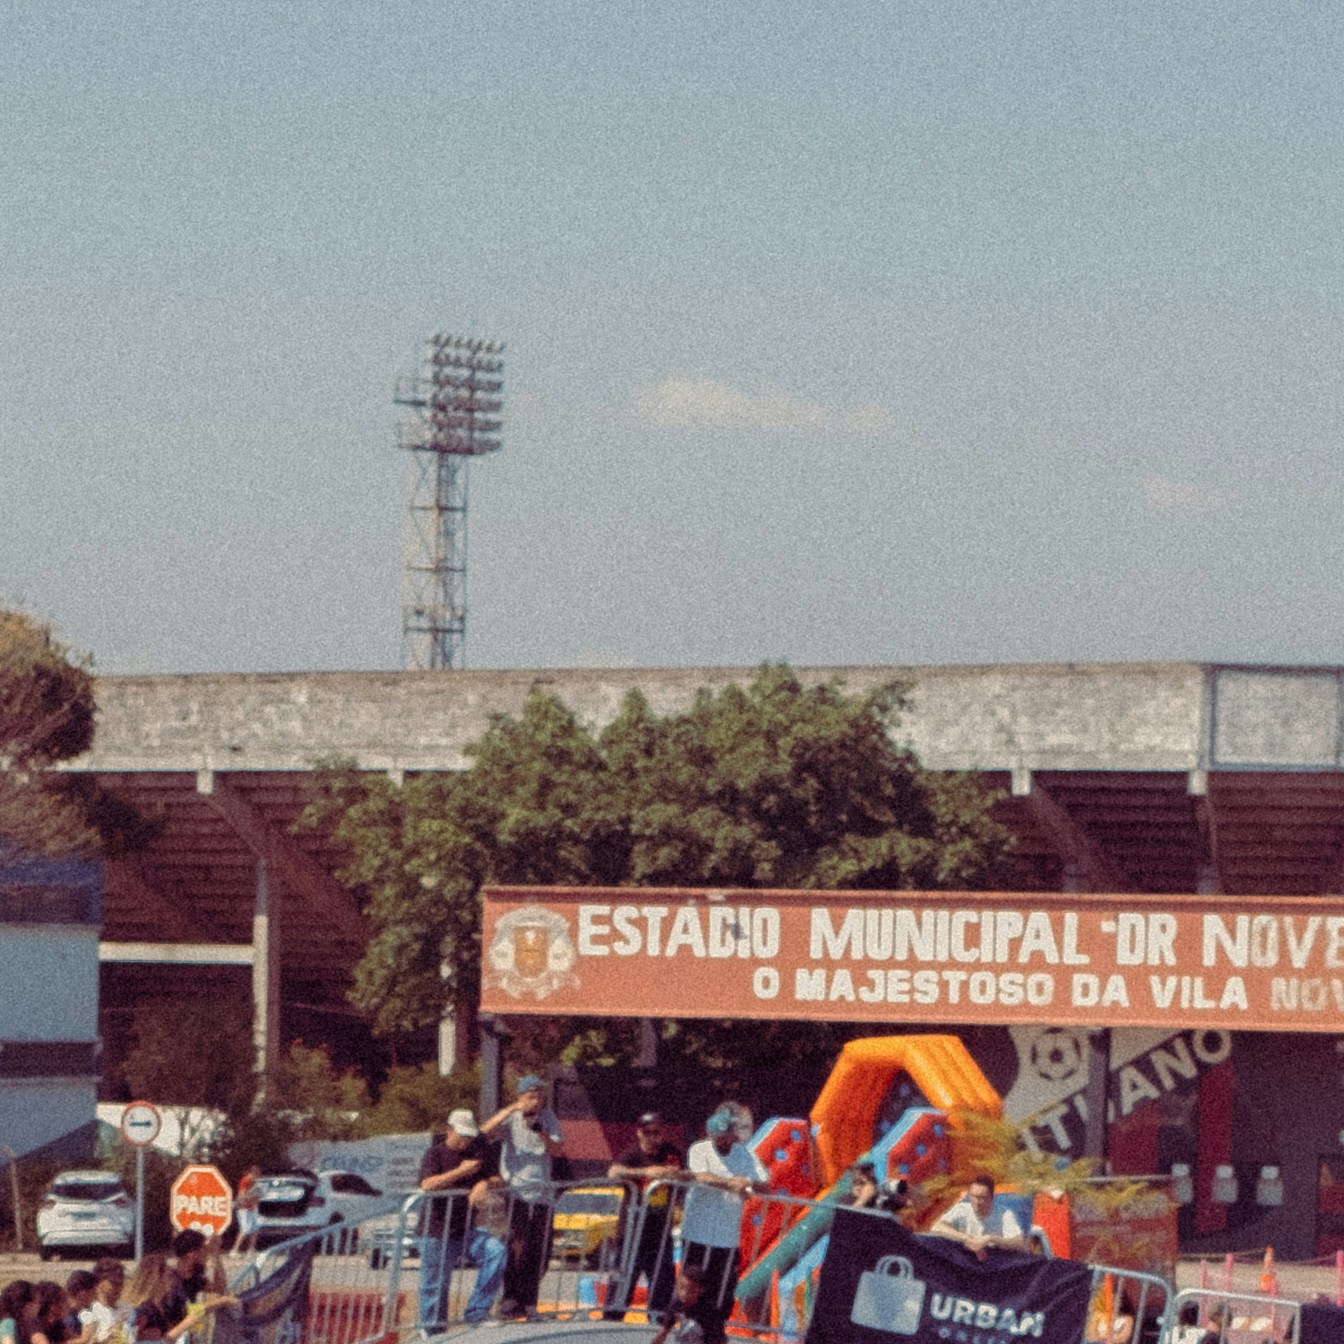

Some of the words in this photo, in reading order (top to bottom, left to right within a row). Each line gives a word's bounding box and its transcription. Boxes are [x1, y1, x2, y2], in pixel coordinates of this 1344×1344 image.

[809, 908, 1090, 965] MUNICIPAL
[752, 967, 780, 1000] O
[795, 968, 1055, 1006] MAJESTOSO
[1071, 973, 1131, 1008] DA
[1150, 975, 1249, 1011] VILA
[176, 1194, 229, 1217] PARE
[929, 1292, 1046, 1338] URBAN
